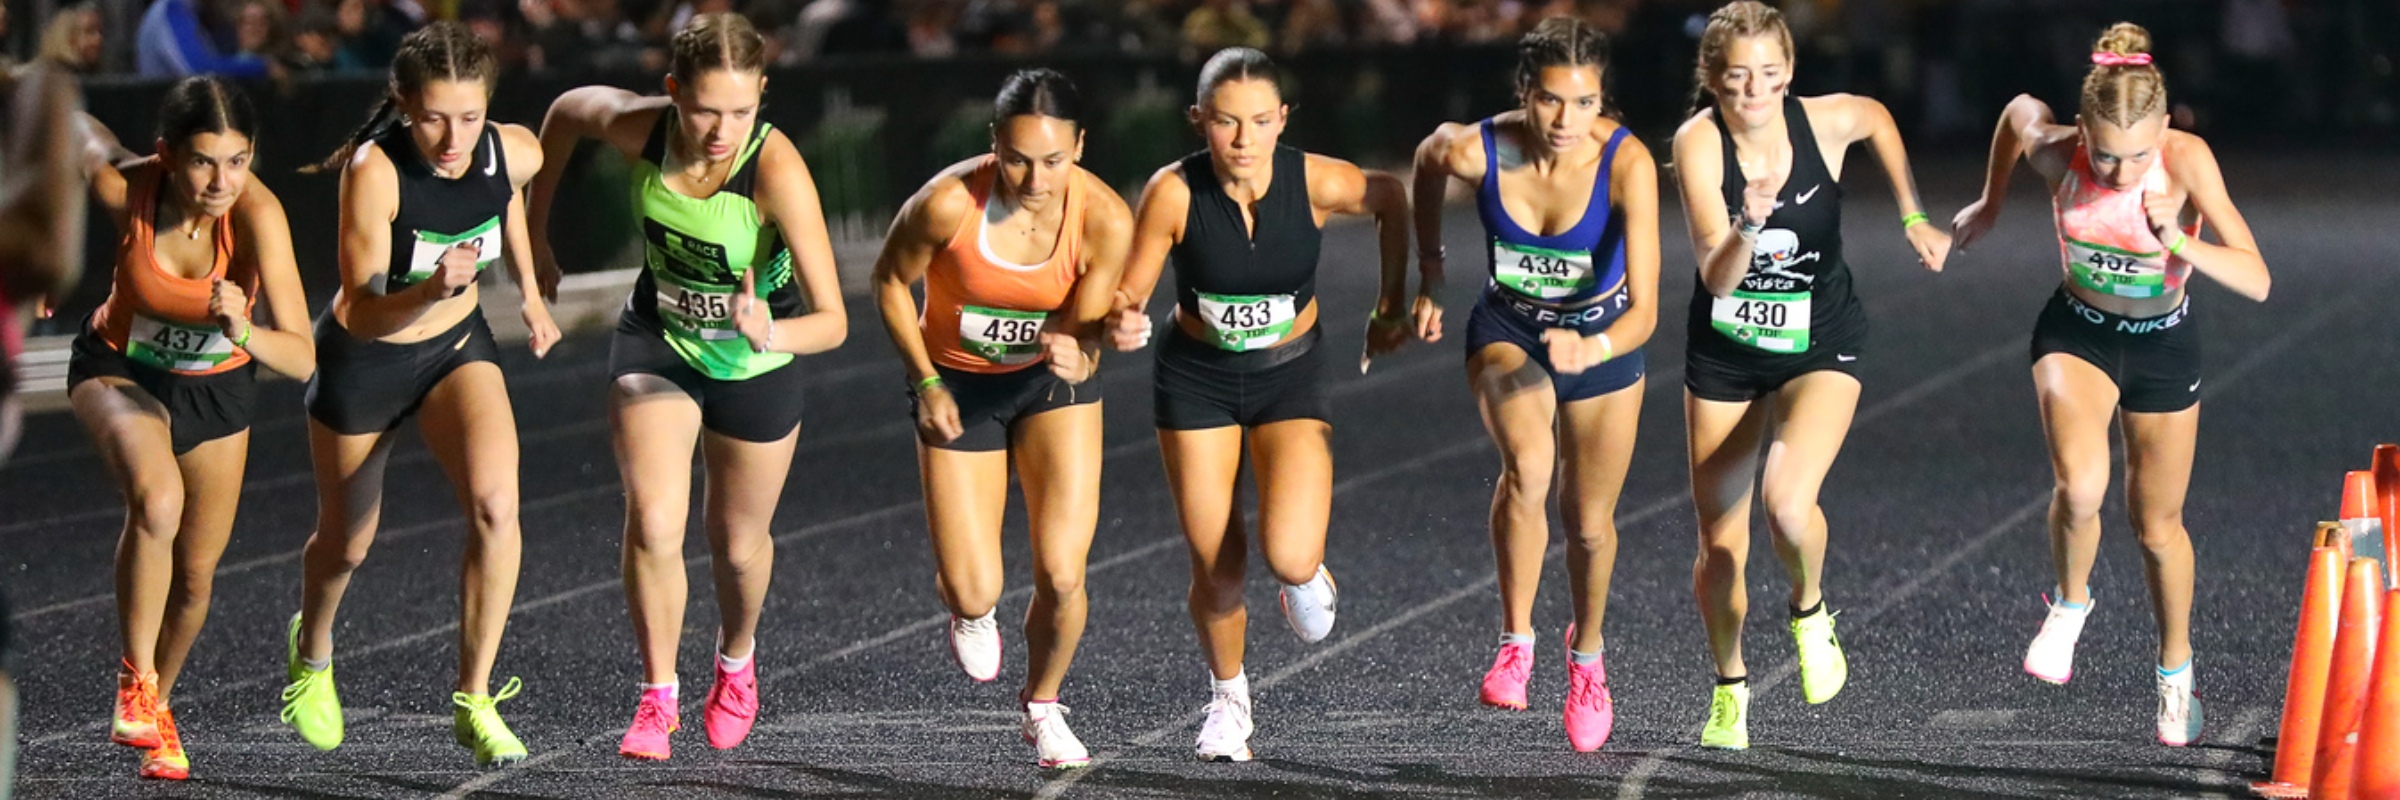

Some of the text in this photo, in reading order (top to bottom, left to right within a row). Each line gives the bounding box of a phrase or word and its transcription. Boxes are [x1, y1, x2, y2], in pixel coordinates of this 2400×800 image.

[687, 239, 719, 259] RACE
[1518, 254, 1570, 278] 434
[676, 289, 727, 319] 435
[1220, 299, 1272, 329] 433
[1536, 306, 1605, 326] PRO
[1735, 300, 1787, 328] 430
[982, 318, 1037, 343] 436
[2116, 309, 2181, 335] NIKE
[152, 326, 211, 353] 437
